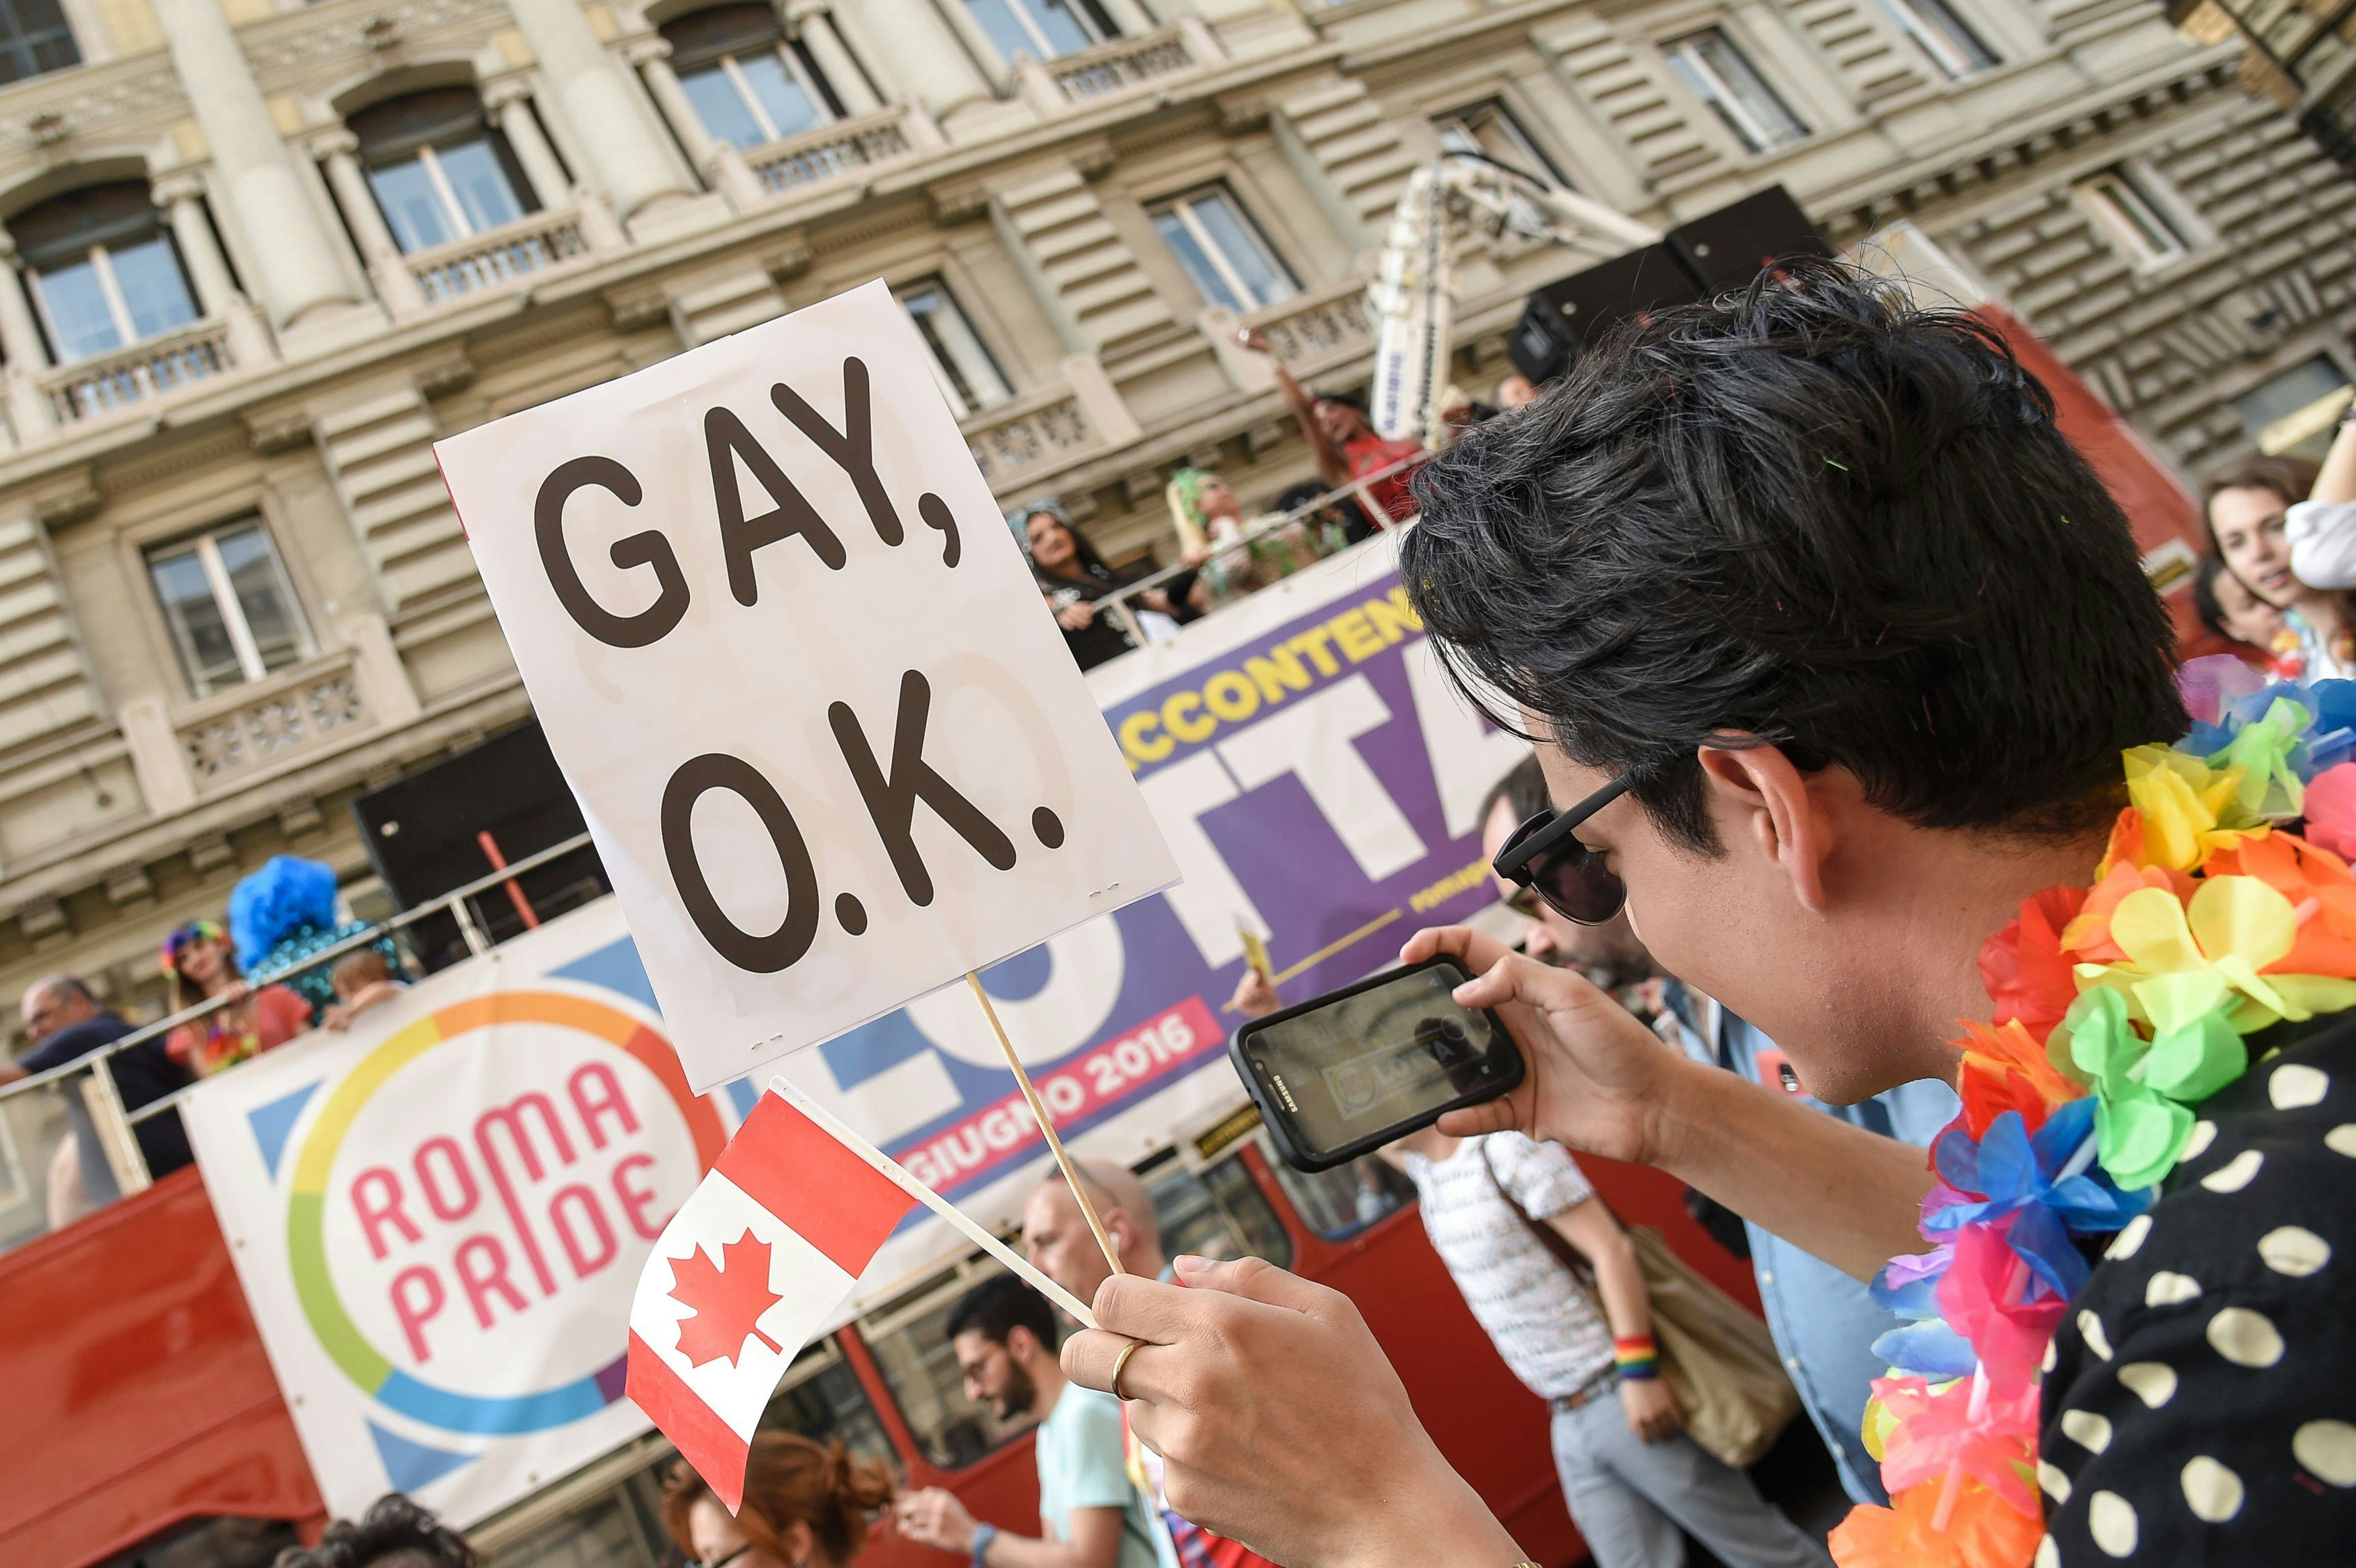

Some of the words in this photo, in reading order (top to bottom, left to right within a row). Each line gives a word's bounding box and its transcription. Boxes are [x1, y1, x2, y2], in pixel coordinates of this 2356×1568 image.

[534, 356, 961, 649] GAY,
[1123, 584, 1427, 773] CCONTEN
[660, 669, 1065, 974] O.K.
[1084, 1013, 1196, 1097] 2016
[1274, 1075, 1298, 1112] SAMSUNG
[349, 1060, 643, 1260] ROMA
[388, 1134, 680, 1364] PRIDE
